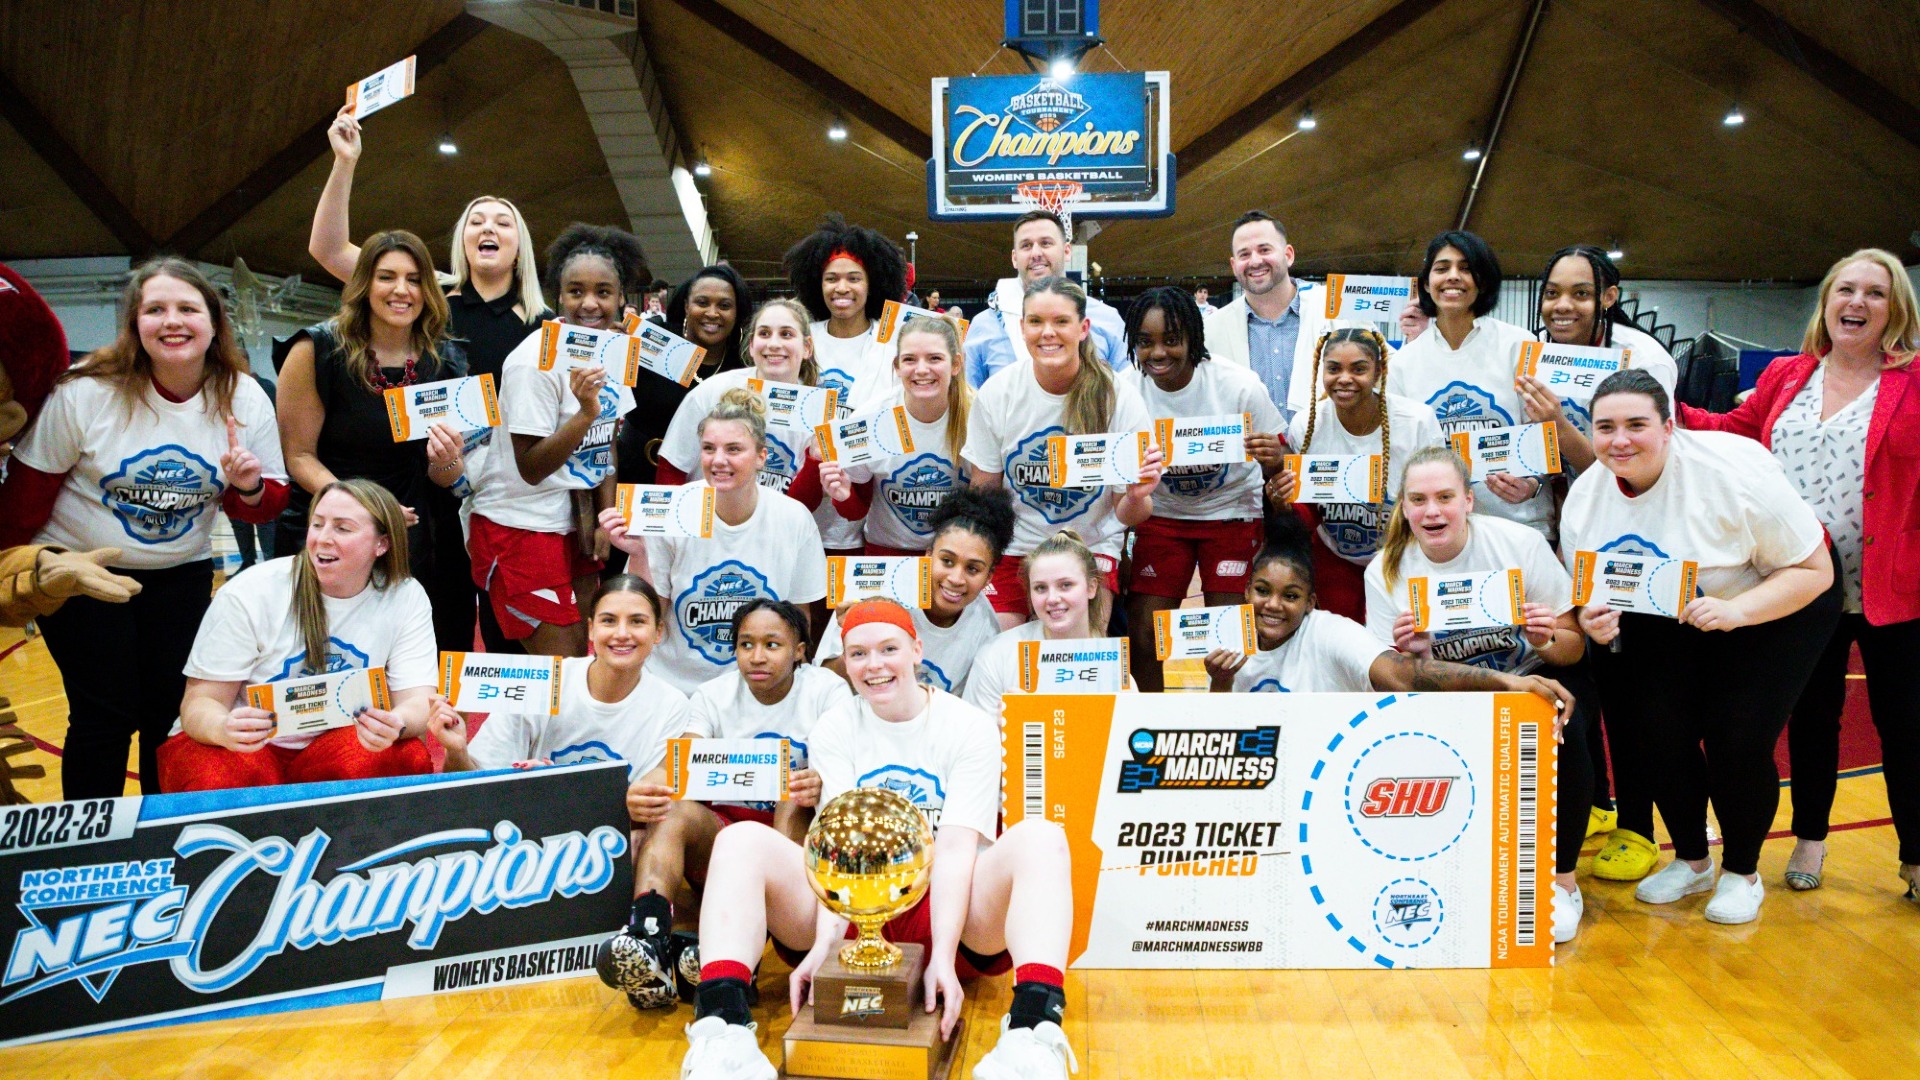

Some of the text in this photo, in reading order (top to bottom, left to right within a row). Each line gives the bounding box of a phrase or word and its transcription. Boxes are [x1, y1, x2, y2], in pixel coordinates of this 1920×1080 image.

[1012, 92, 1084, 112] BASKETBALL
[1020, 106, 1075, 116] TOURNAMENT
[953, 105, 1140, 167] Champions
[972, 171, 1123, 182] WOMEN'S BASKETBALL
[1344, 285, 1409, 297] MARCHMADNESS
[1541, 354, 1618, 371] MARCHMADNESS
[433, 405, 449, 413] TICKET
[1448, 399, 1468, 413] NEC
[1175, 425, 1242, 437] MARCHMADNESS
[155, 469, 186, 479] NEC
[1217, 560, 1248, 576] SHU
[719, 580, 743, 591] NEC
[1041, 651, 1118, 663] MARCHMADNESS
[464, 666, 550, 681] MARCHMADNESS
[294, 684, 316, 693] MARCH
[297, 688, 328, 698] MADNESS
[308, 700, 328, 709] TICKET
[1054, 709, 1065, 759] SEAT 23
[1133, 741, 1154, 749] NCAA
[1154, 732, 1237, 757] MARCH
[691, 753, 778, 765] MARCHMADNESS
[1164, 757, 1276, 781] MADNESS
[1359, 776, 1455, 818] SHU
[1054, 804, 1066, 819] 12
[0, 799, 115, 850] 2022-23
[1117, 822, 1282, 847] 2023 TICKET
[1498, 707, 1511, 960] NCAA TOURNAMENT AUTOMATIC QUALIFIER
[1139, 850, 1259, 877] PUNCHED
[21, 859, 174, 889] NORTHEAST
[21, 877, 173, 904] CONFERENCE
[172, 820, 628, 994] Champions
[1385, 901, 1431, 924] NEC
[1145, 920, 1249, 932] #MARCHMADNESS
[2, 885, 189, 988] NEC
[1131, 941, 1263, 952] @MARCHMADNESSWBB
[433, 943, 599, 991] WOMEN'S BASKETBALL
[841, 994, 884, 1014] NEC
